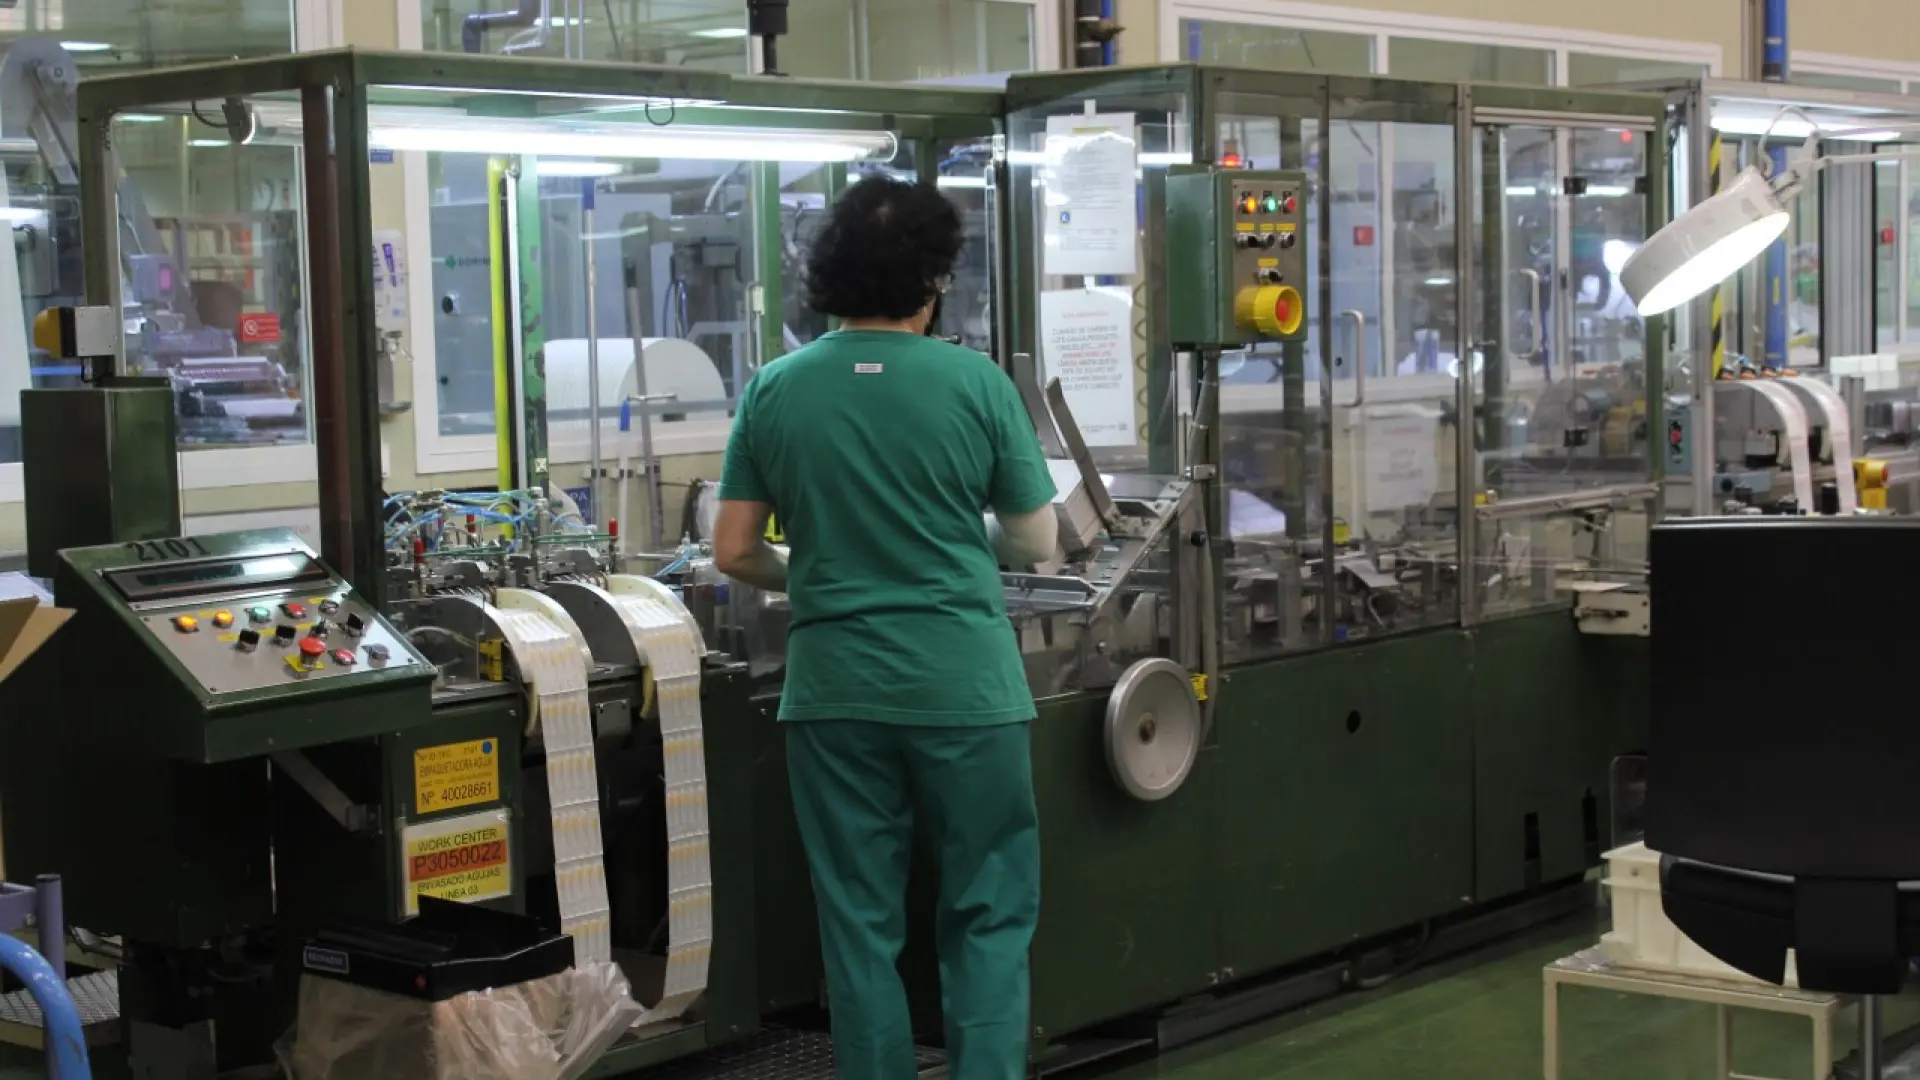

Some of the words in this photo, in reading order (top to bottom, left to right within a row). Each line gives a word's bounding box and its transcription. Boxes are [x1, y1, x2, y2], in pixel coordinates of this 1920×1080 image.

[458, 257, 490, 268] DOMIN
[127, 537, 211, 562] 2101
[441, 780, 492, 802] 40028661
[417, 836, 451, 852] WORK
[453, 828, 498, 846] CENTER
[414, 841, 502, 875] P3050022
[418, 874, 463, 892] ENVASADO
[467, 867, 501, 882] AGUJAS
